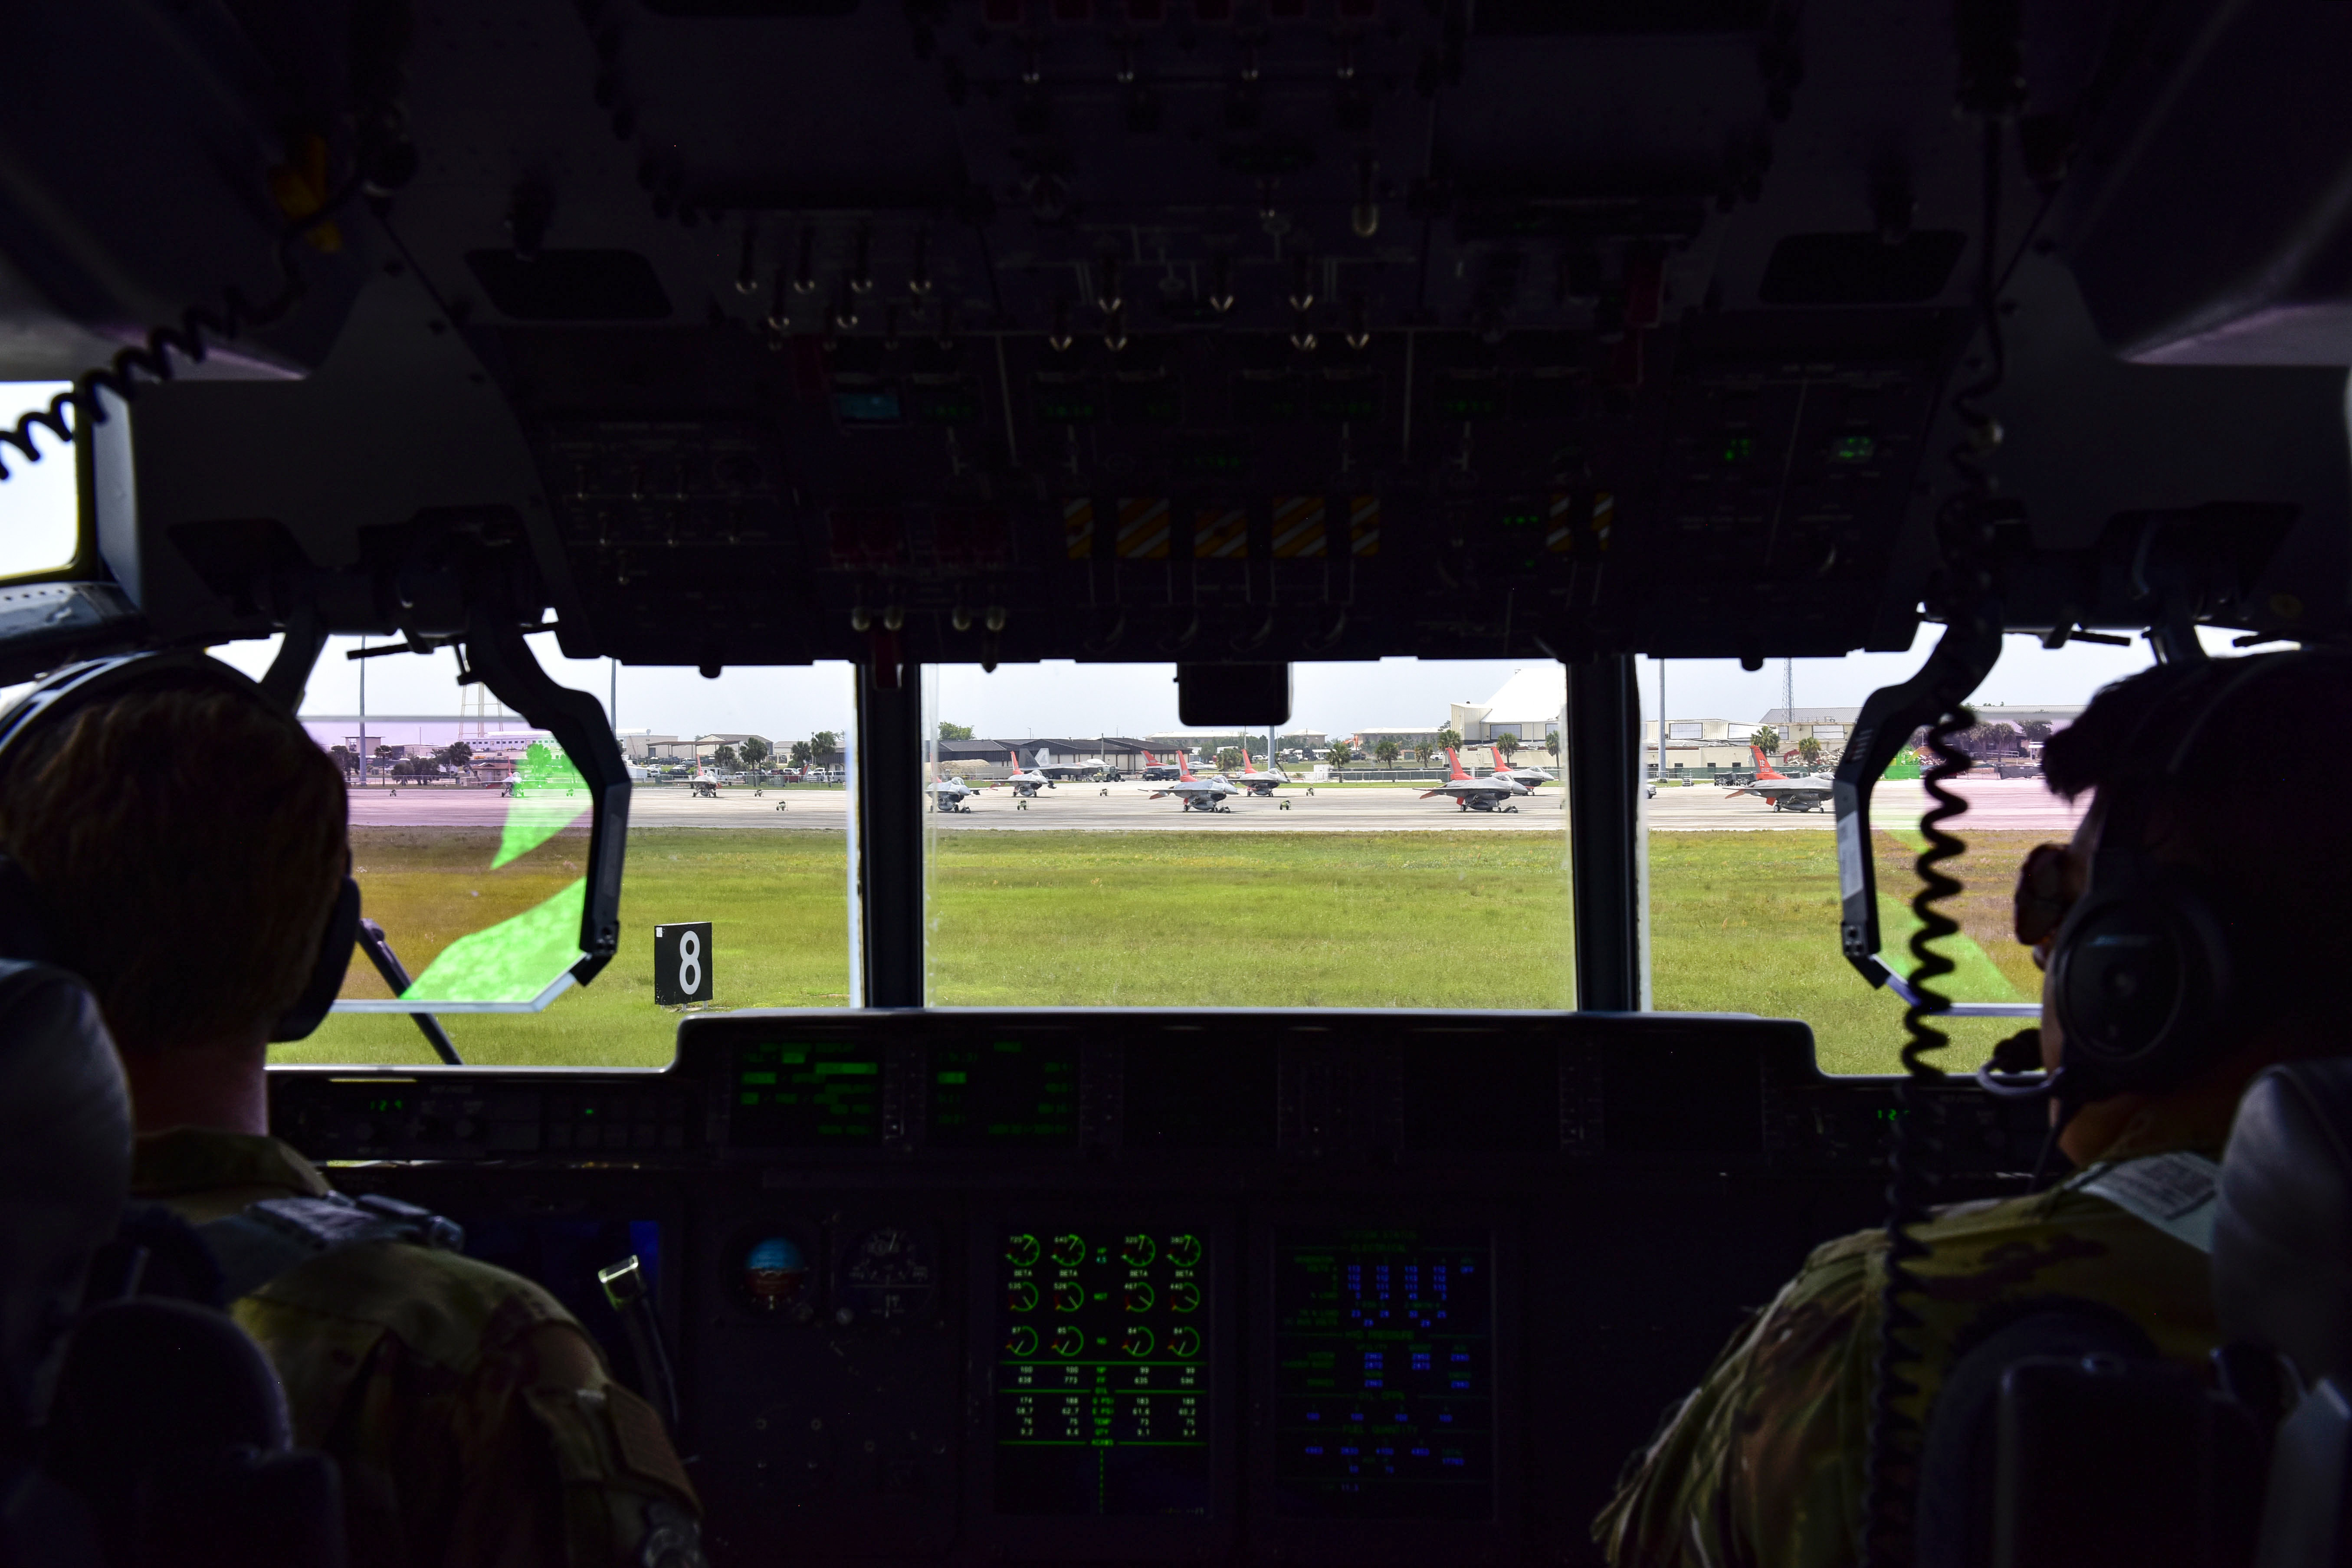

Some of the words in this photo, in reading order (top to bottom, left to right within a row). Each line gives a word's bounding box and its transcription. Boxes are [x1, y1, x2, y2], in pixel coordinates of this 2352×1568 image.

[679, 931, 701, 995] 8
[1013, 1269, 1033, 1278] BETA
[1059, 1269, 1078, 1278] BETA
[1129, 1269, 1148, 1278] BETA
[1174, 1269, 1194, 1279] BETA
